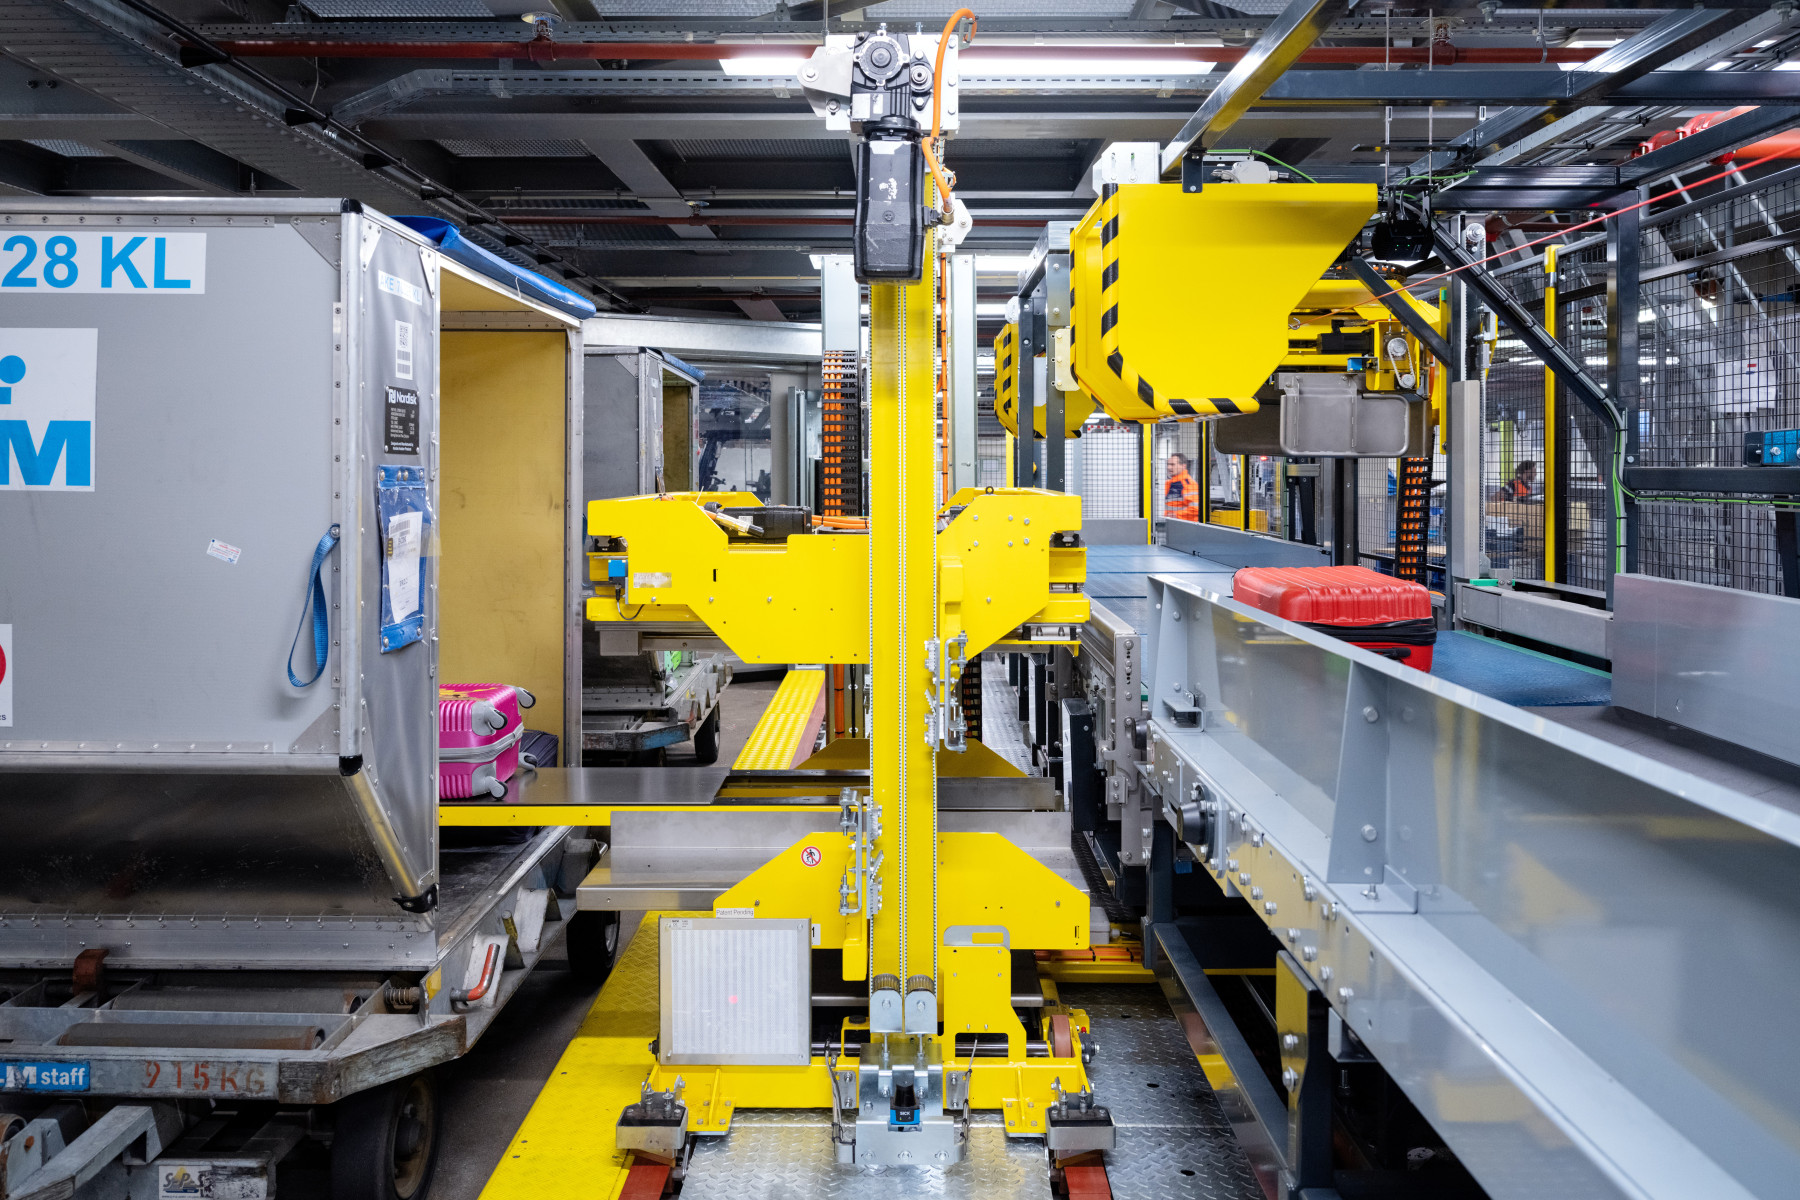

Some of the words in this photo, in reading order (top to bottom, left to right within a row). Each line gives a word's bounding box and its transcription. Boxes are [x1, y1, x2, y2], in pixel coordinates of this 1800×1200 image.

[2, 234, 79, 289] 28
[101, 235, 192, 290] KL
[397, 391, 417, 405] Nordisk
[716, 908, 733, 916] Patent
[733, 908, 754, 917] Pending
[41, 1067, 86, 1086] staff
